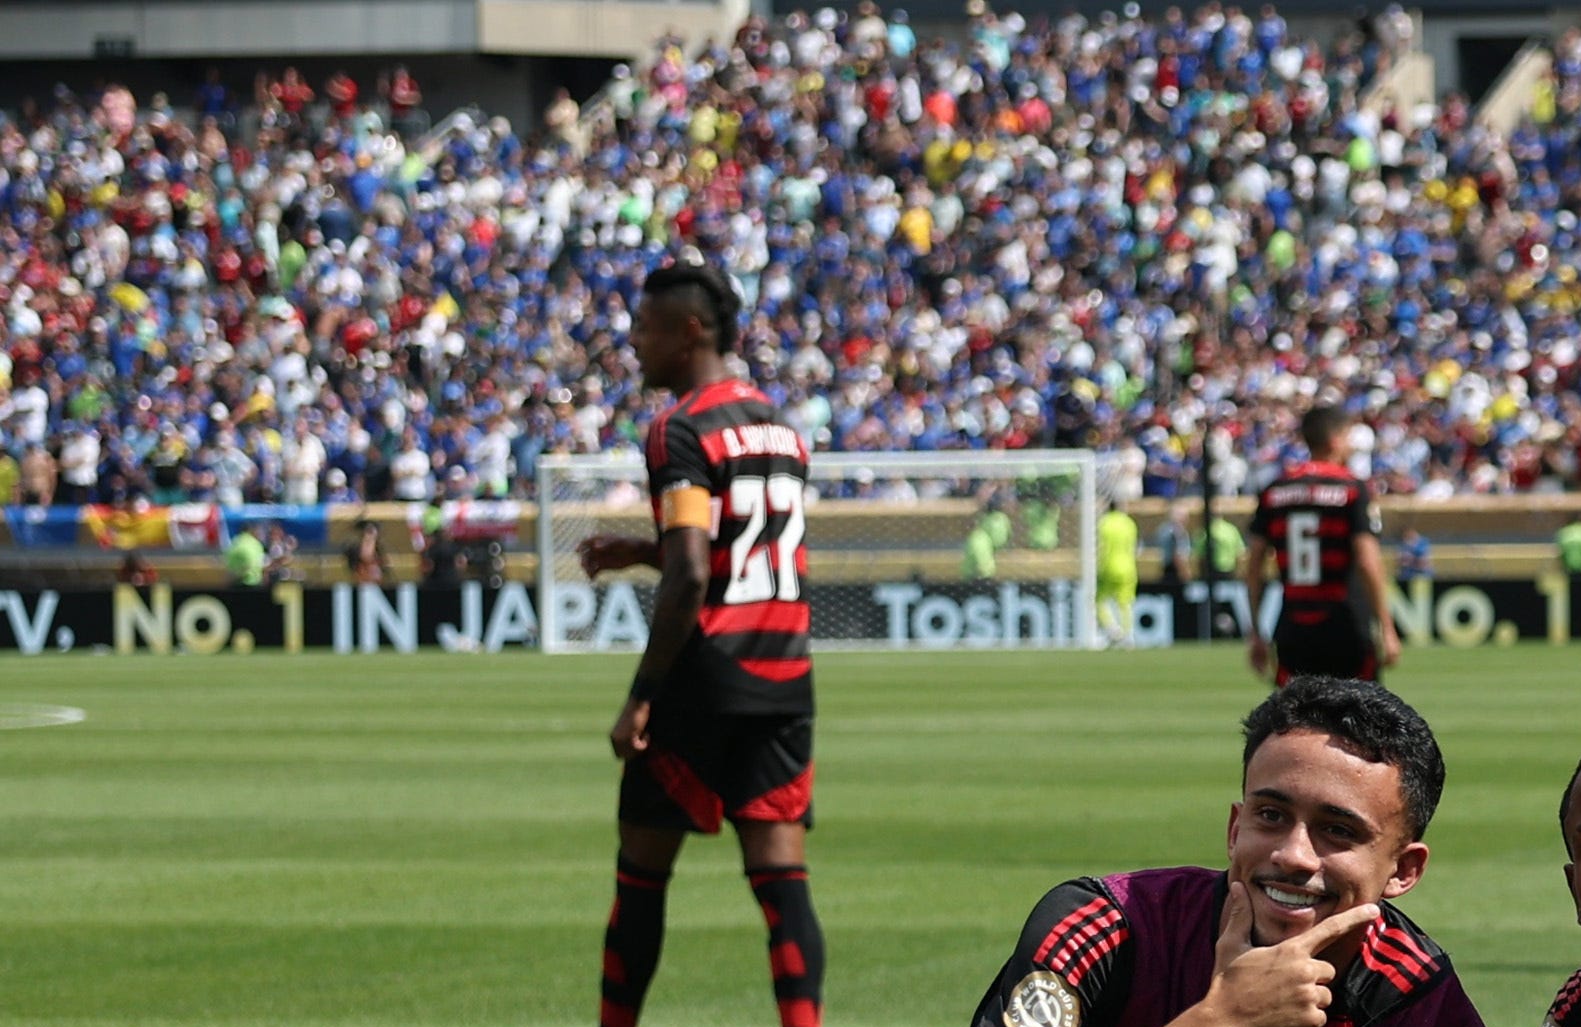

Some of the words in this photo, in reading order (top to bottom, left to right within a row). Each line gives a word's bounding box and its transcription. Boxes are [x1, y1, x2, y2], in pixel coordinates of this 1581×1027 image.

[723, 474, 805, 604] 27
[1286, 512, 1322, 586] 6
[0, 588, 76, 655] V,
[113, 579, 256, 655] No.
[272, 580, 305, 653] 1
[331, 580, 418, 654] IN
[436, 579, 651, 654] JAPA
[872, 578, 1175, 649] Toshia
[1535, 572, 1571, 645] 1
